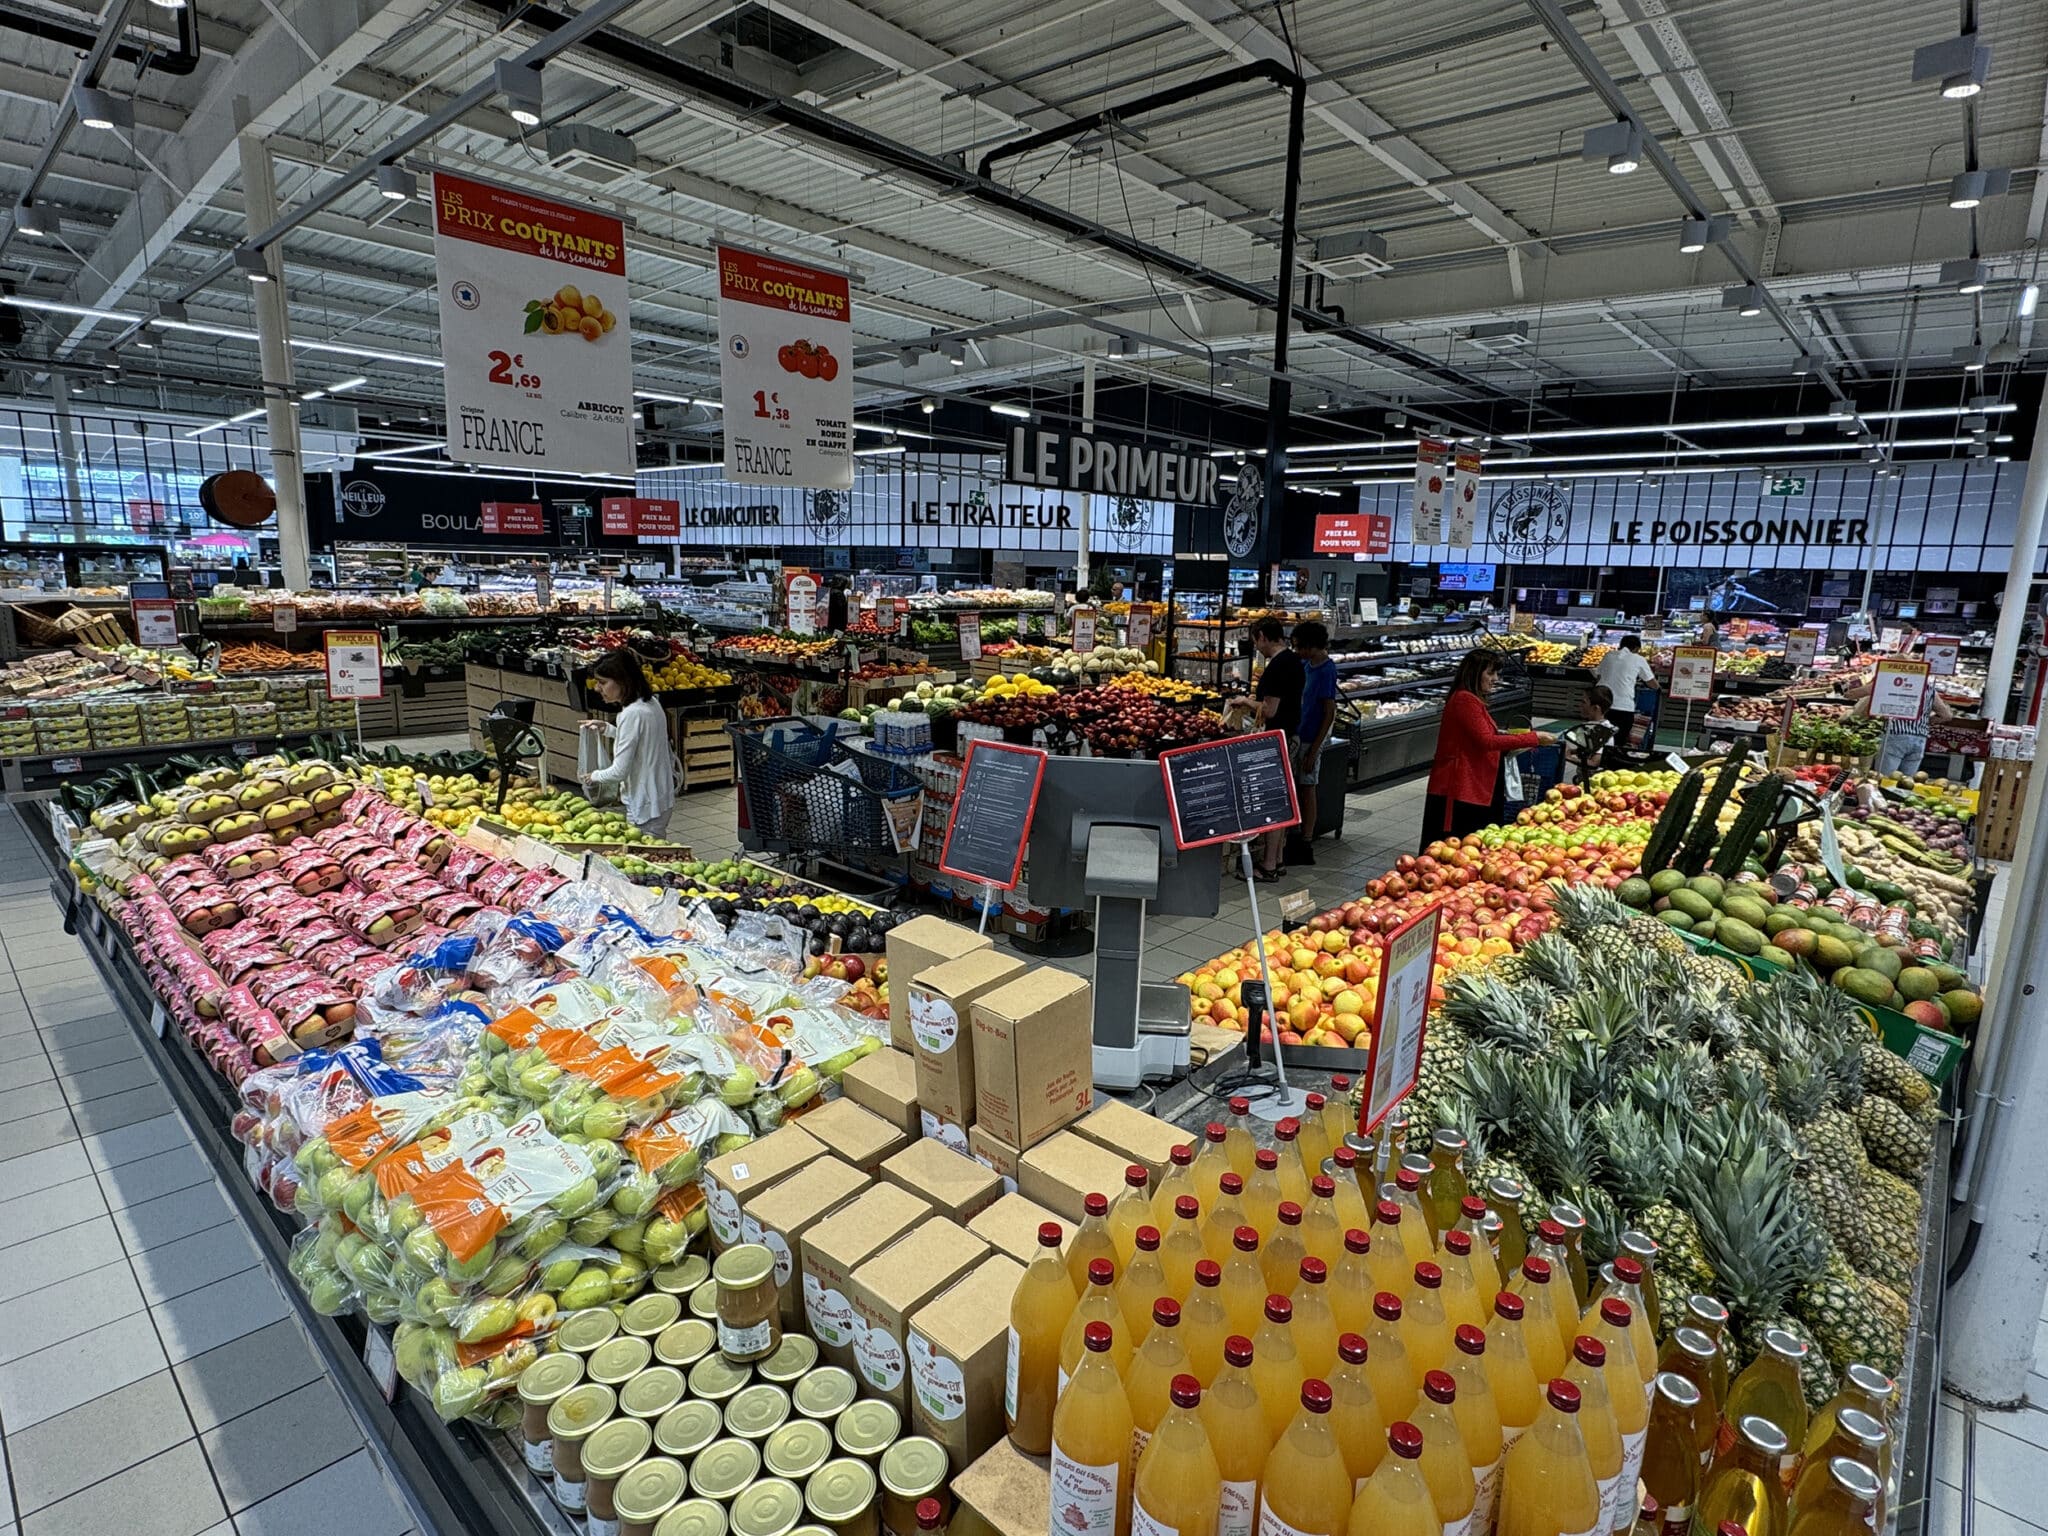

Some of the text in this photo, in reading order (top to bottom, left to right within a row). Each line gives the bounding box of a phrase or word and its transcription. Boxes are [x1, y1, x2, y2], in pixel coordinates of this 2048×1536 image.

[441, 189, 463, 206] LES
[443, 202, 495, 231] PRIX
[539, 244, 608, 269] de la semaine
[723, 261, 738, 273] LES
[724, 272, 759, 292] PRIX
[460, 405, 485, 415] Origine
[560, 409, 588, 420] Calibre
[577, 401, 624, 415] ABRICOT
[461, 414, 545, 456] FRANCE
[816, 419, 847, 428] TOMATE
[821, 430, 846, 439] RONDE
[806, 439, 846, 449] EN GRAPPE
[735, 445, 792, 476] FRANCE
[1012, 426, 1218, 505] LE PRIMEUR
[686, 505, 780, 525] LE CHARCUTIER
[911, 500, 1071, 528] LE TRAITEUR
[1611, 518, 1869, 545] LE POISSONNIER
[1395, 922, 1433, 960] PRIX BAS
[975, 1017, 1008, 1041] Bag-in-Box
[944, 1105, 956, 1116] 3L
[1076, 1088, 1091, 1111] 3L
[553, 1144, 583, 1176] croquer
[975, 1143, 1010, 1169] Bag-in-Box
[807, 1255, 842, 1283] Bag-in-Box
[855, 1295, 893, 1329] Bag-in-Box
[1069, 1474, 1083, 1484] Pur
[1073, 1484, 1102, 1495] Pommes
